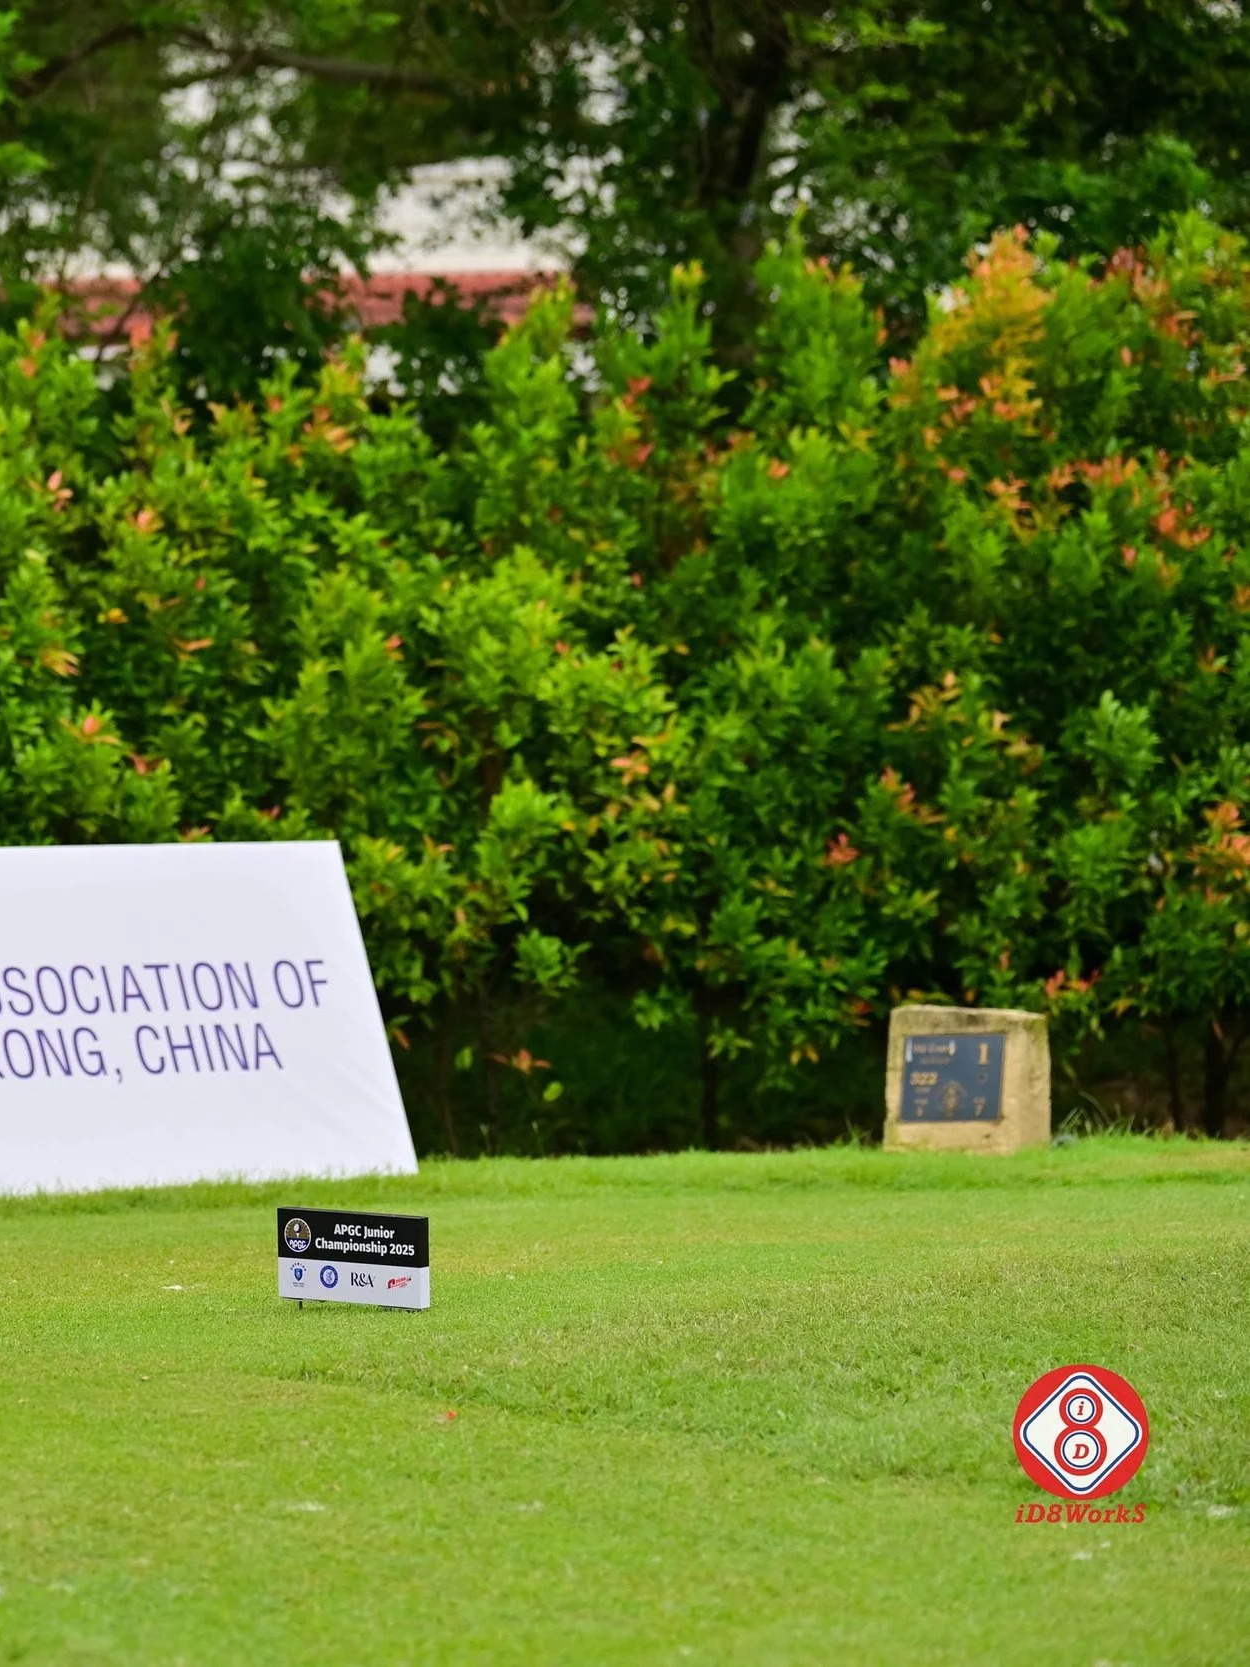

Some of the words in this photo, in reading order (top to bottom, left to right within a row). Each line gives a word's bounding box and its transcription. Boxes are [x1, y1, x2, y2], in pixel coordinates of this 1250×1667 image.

[273, 960, 328, 1009] OF
[135, 1023, 284, 1075] CHINA
[978, 1043, 989, 1066] 1
[334, 1223, 362, 1236] APGC
[363, 1225, 395, 1239] Junior
[290, 1239, 307, 1250] APGC
[314, 1237, 388, 1256] Championship
[389, 1243, 415, 1256] 2025
[350, 1271, 376, 1288] R&A
